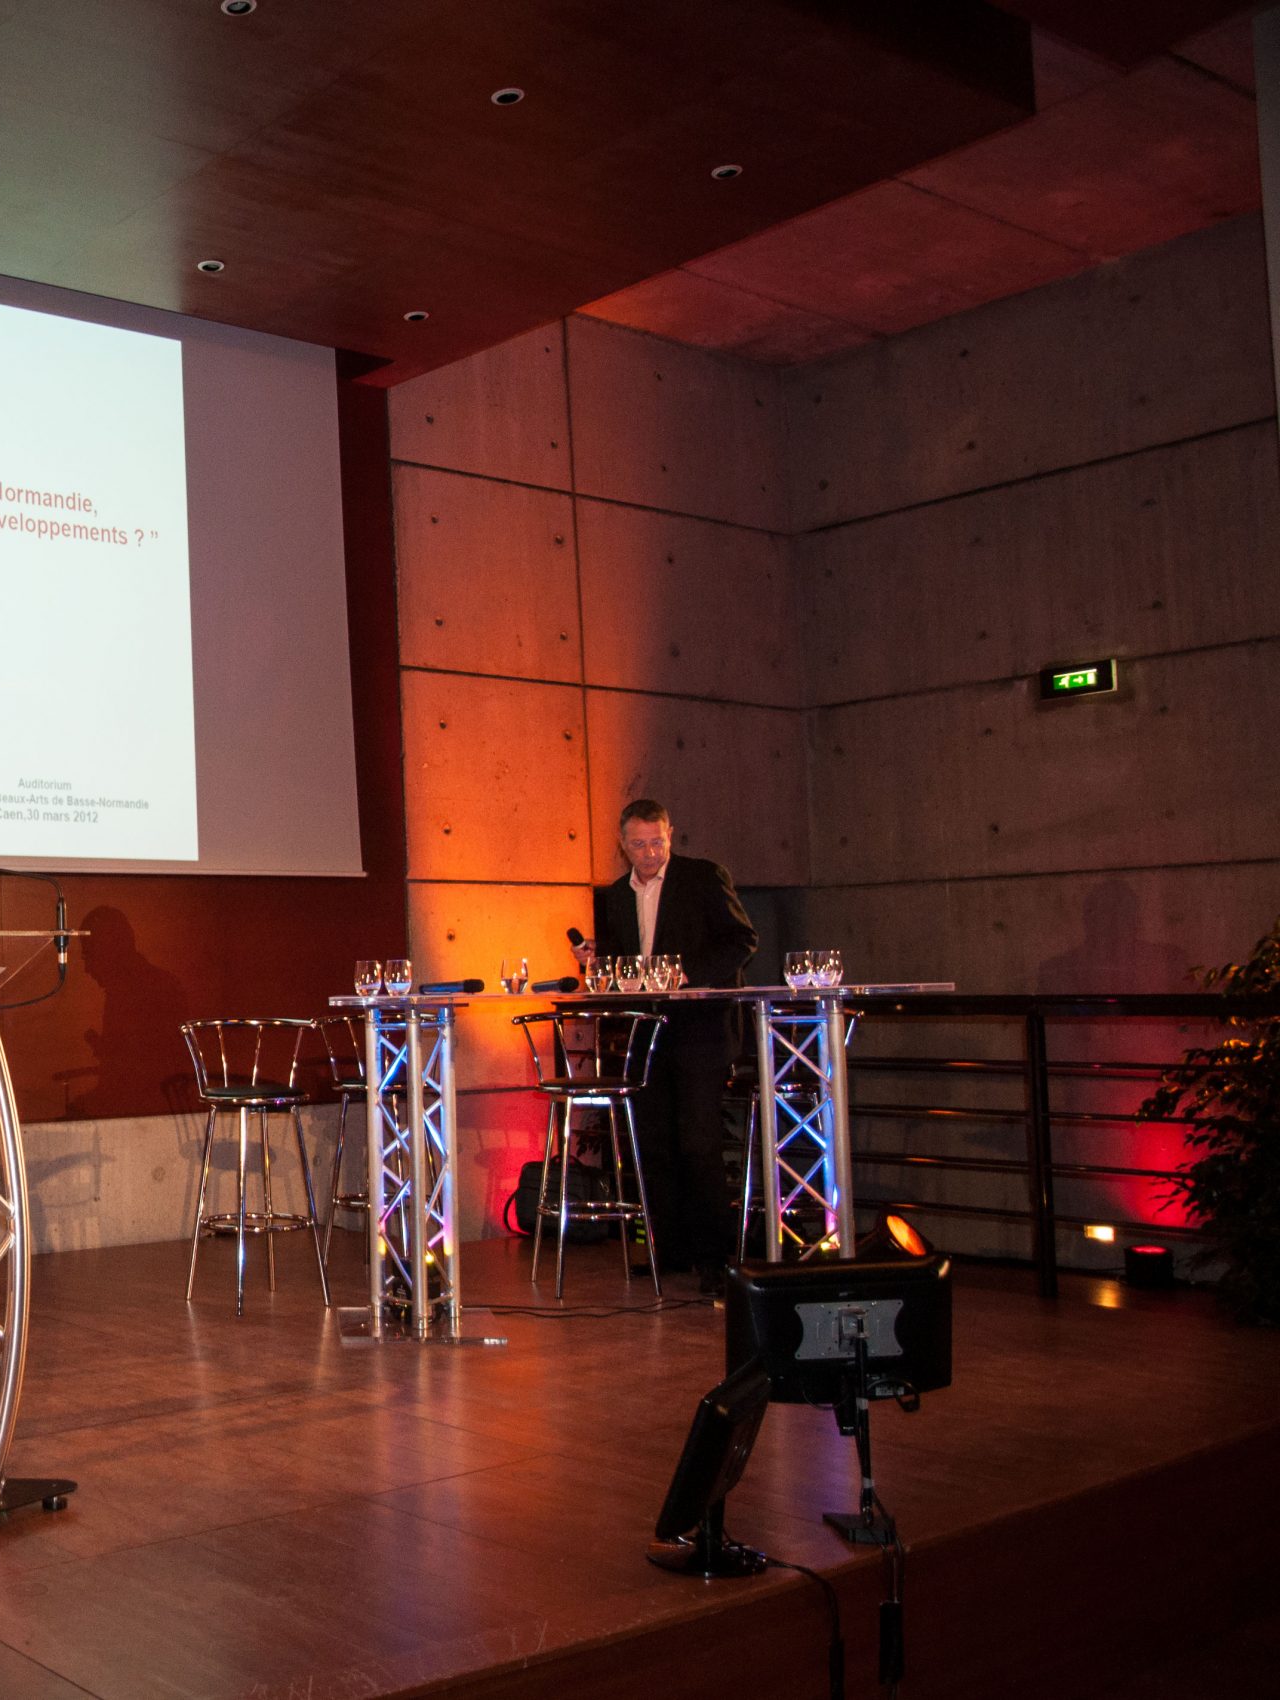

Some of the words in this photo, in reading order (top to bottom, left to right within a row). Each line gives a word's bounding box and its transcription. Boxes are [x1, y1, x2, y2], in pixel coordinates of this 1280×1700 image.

[18, 778, 72, 791] Auditorium
[52, 794, 64, 806] de
[67, 795, 150, 810] Basse-Normandie
[42, 810, 71, 822] mars
[73, 810, 99, 824] 2012
